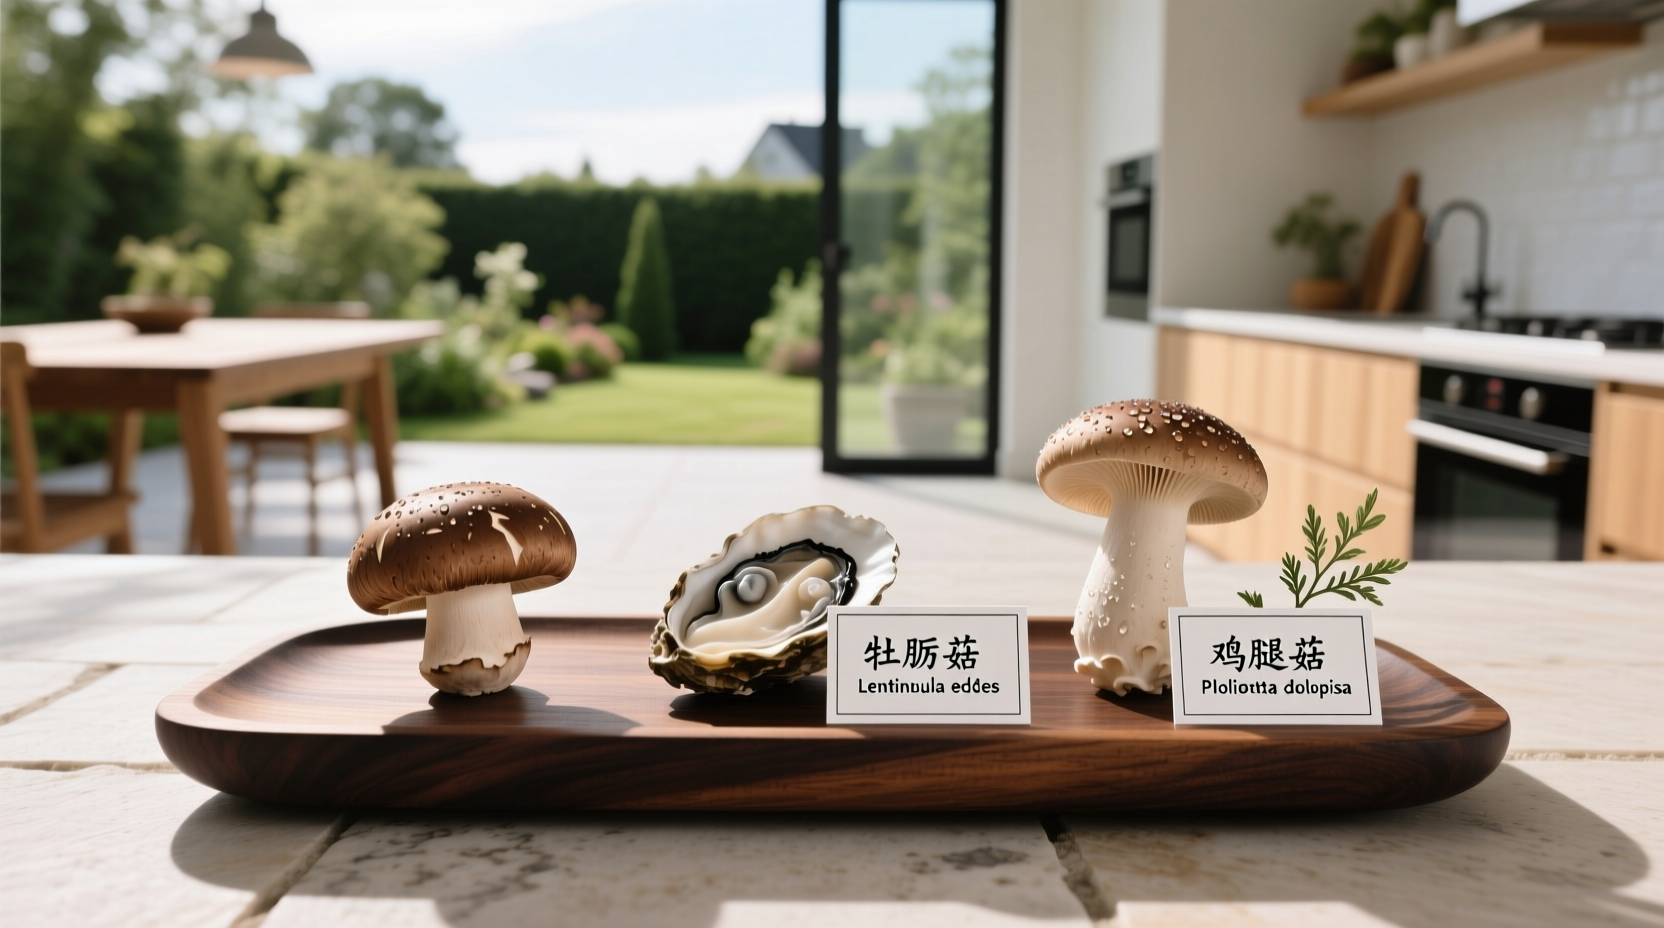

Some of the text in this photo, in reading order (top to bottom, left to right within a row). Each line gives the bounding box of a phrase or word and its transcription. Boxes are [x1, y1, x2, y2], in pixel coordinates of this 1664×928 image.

[1209, 634, 1326, 673] 鸡腿菇
[1283, 678, 1352, 699] dolopisa
